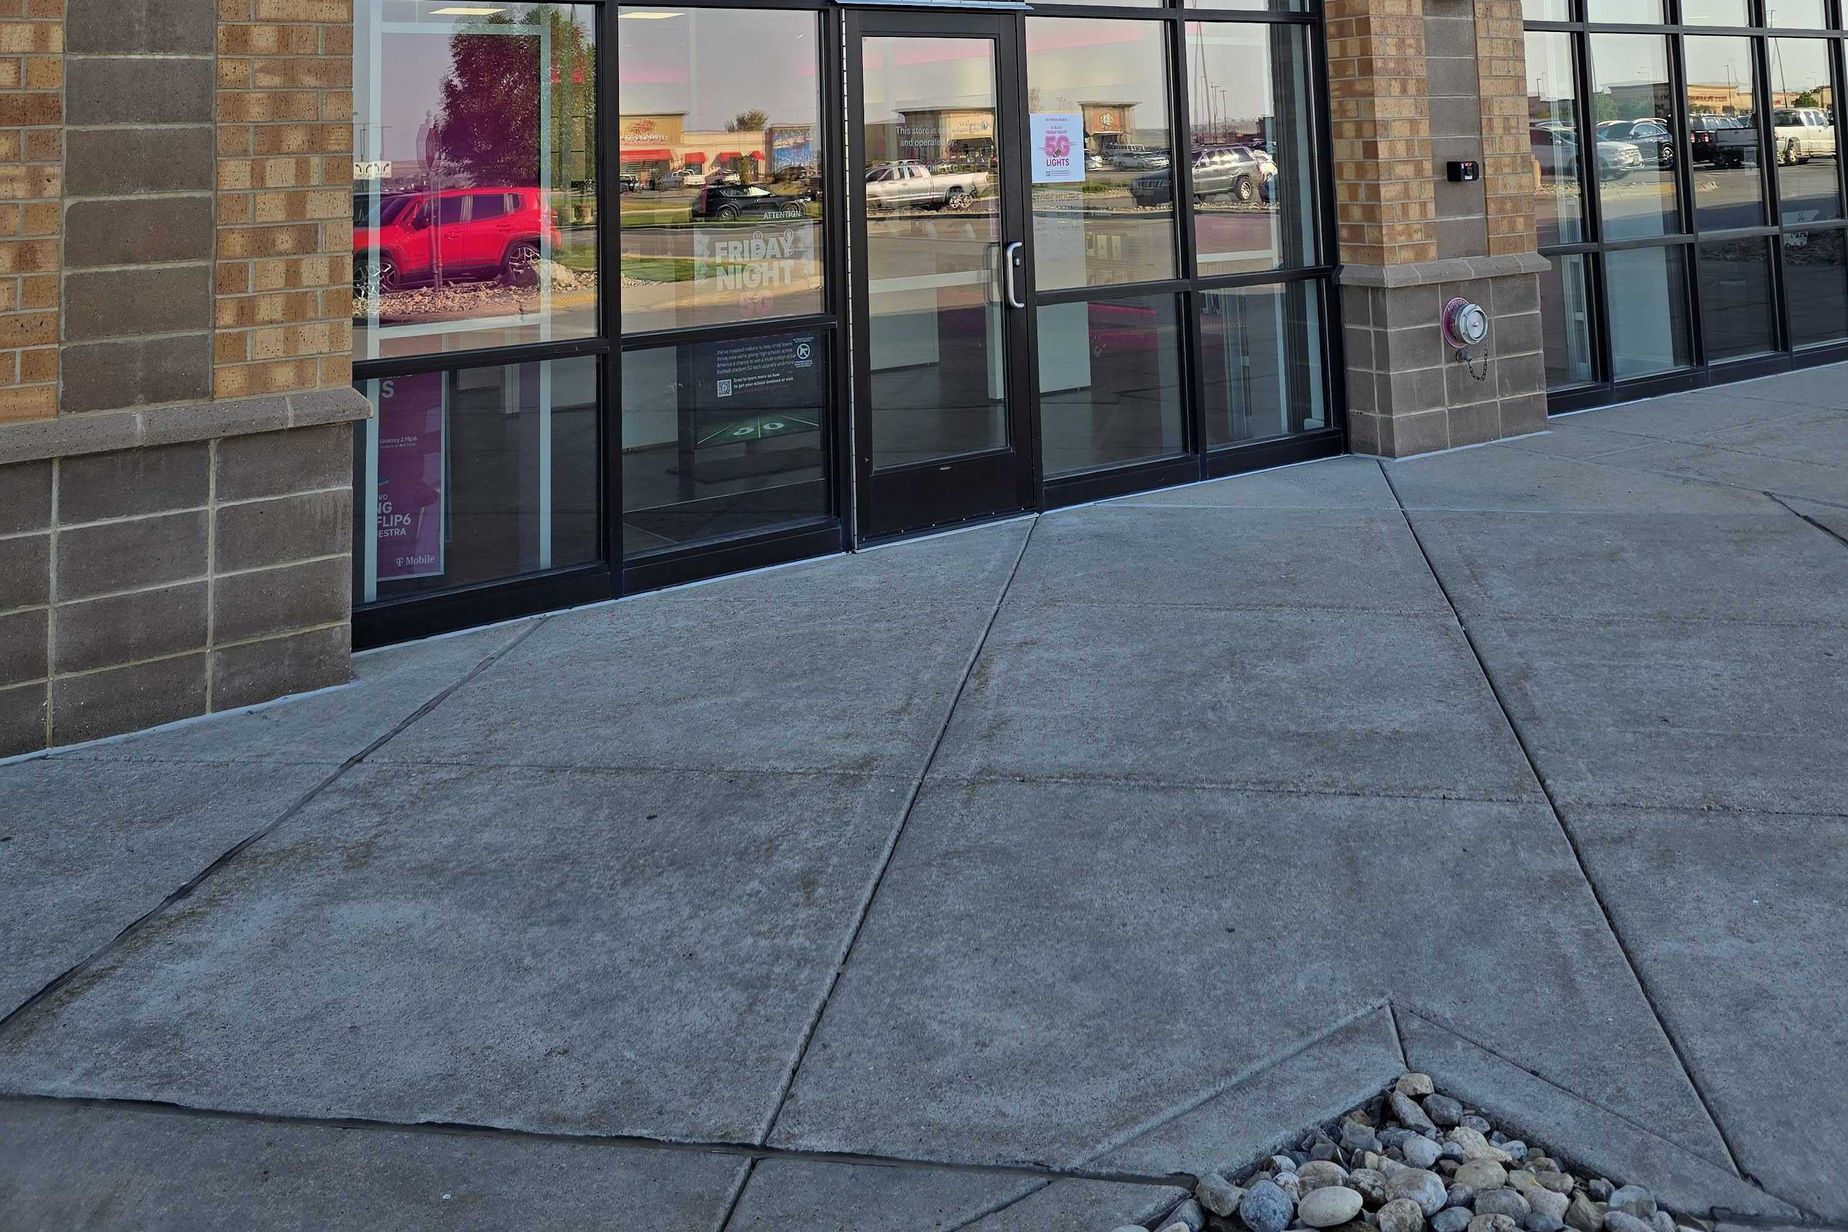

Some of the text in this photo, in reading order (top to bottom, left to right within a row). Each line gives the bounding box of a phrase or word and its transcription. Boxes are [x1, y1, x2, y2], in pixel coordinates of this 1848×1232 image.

[896, 127, 911, 135] This
[911, 127, 931, 135] store
[900, 138, 913, 147] and
[1045, 135, 1071, 158] 5G
[1046, 158, 1070, 167] LIGHTS
[763, 210, 801, 219] ATTENTION
[715, 235, 795, 263] FRIDAY
[716, 260, 795, 291] NIGHT
